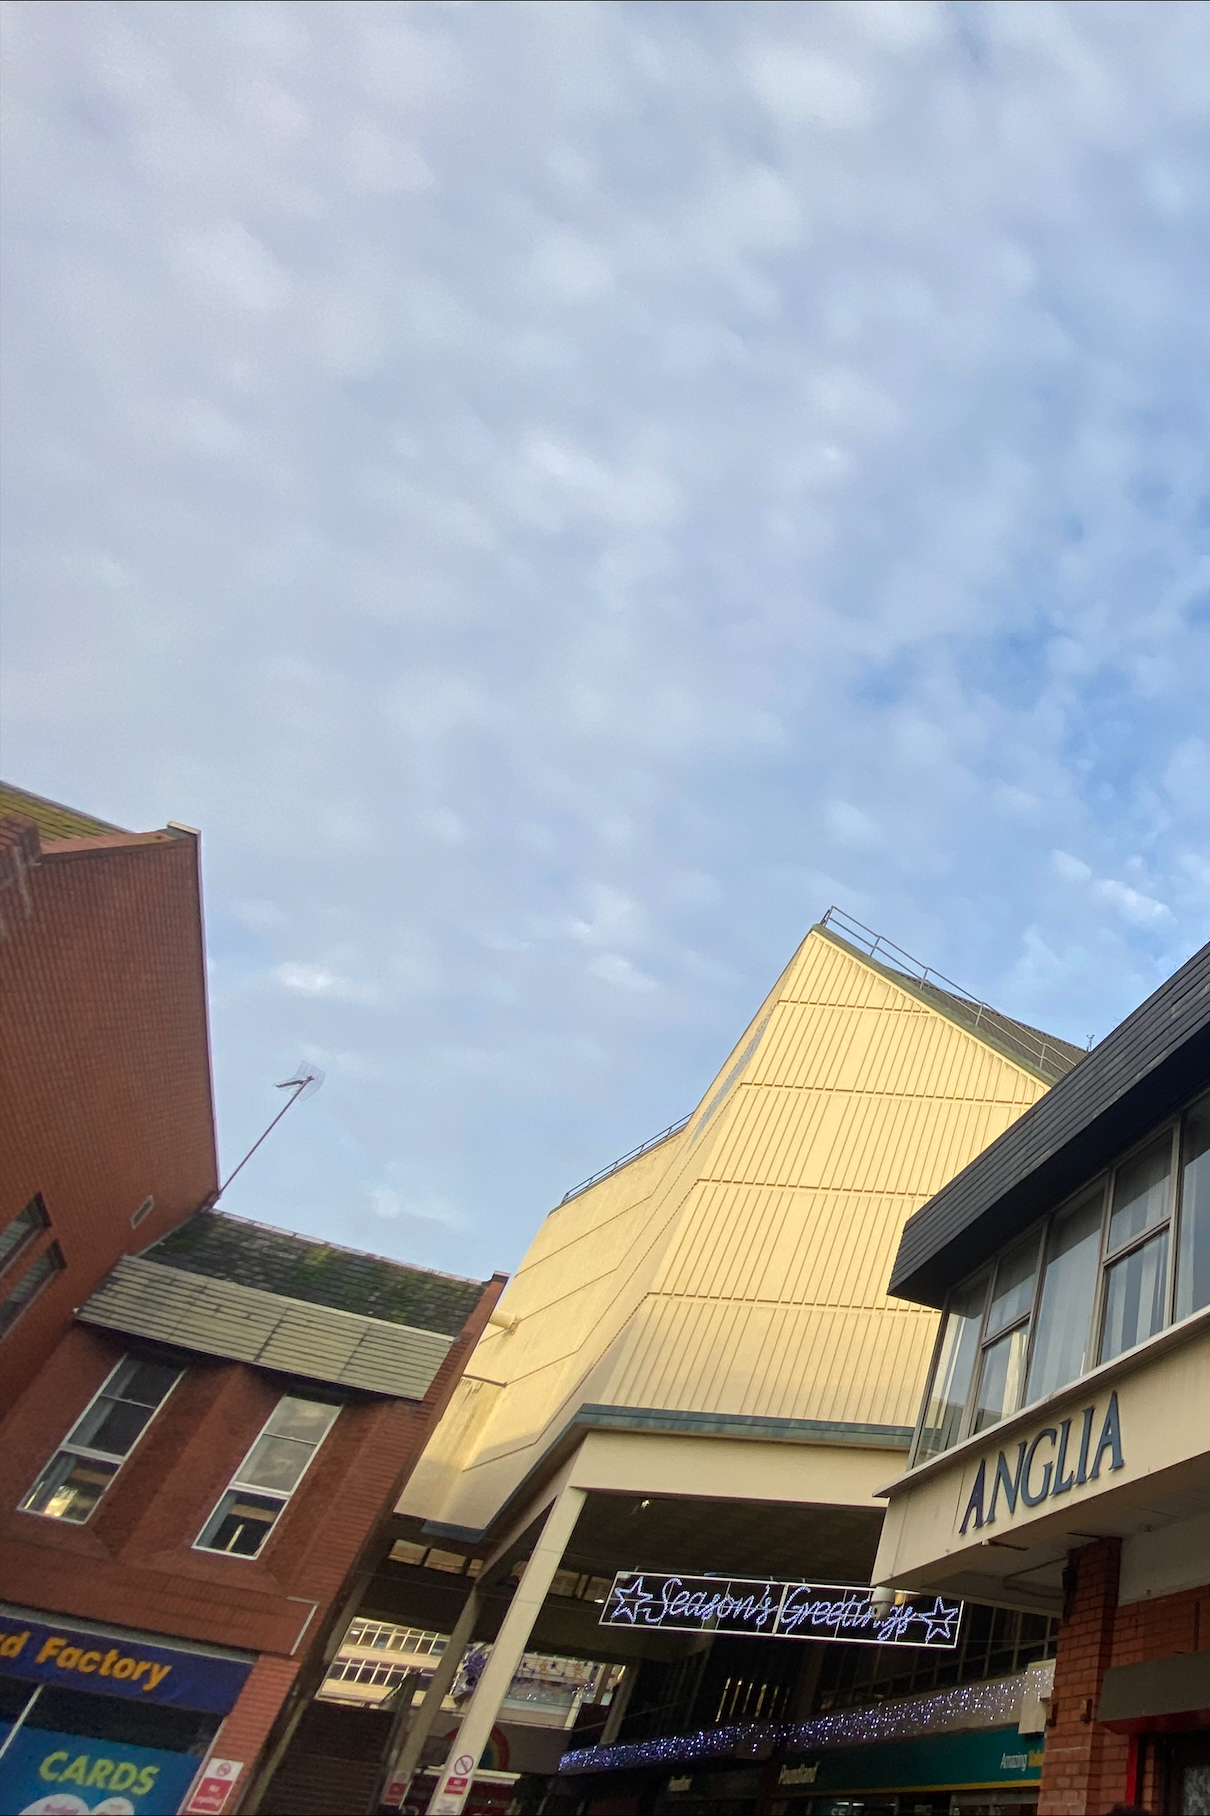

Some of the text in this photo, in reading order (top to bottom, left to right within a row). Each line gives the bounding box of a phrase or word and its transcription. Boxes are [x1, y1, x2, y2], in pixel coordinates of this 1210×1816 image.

[959, 1391, 1125, 1535] ANGLIA
[645, 1577, 778, 1626] Season's
[35, 1637, 173, 1691] Factory
[39, 1751, 161, 1796] CARDS
